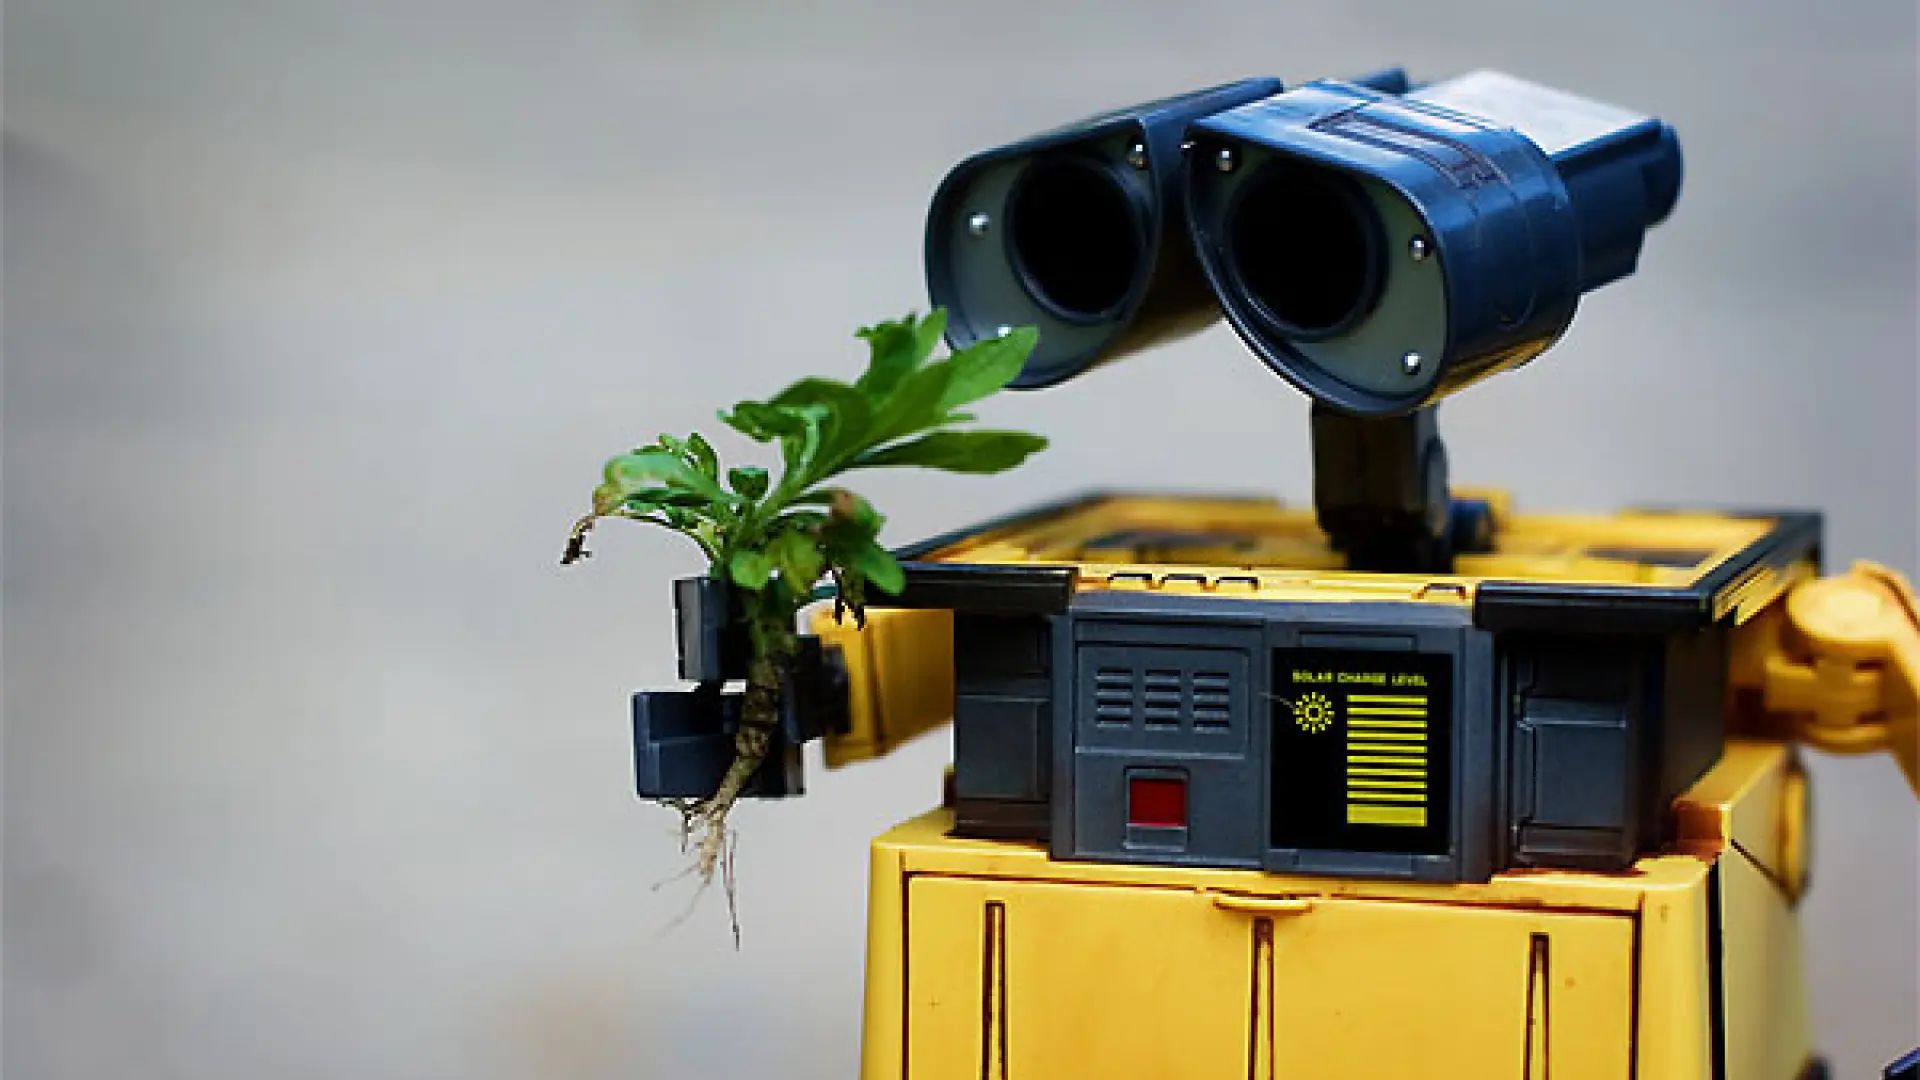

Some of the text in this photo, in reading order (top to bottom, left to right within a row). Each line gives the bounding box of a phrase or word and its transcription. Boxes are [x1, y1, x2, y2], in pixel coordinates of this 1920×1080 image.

[1292, 670, 1428, 687] SOLAR CHARGE LEVEL
